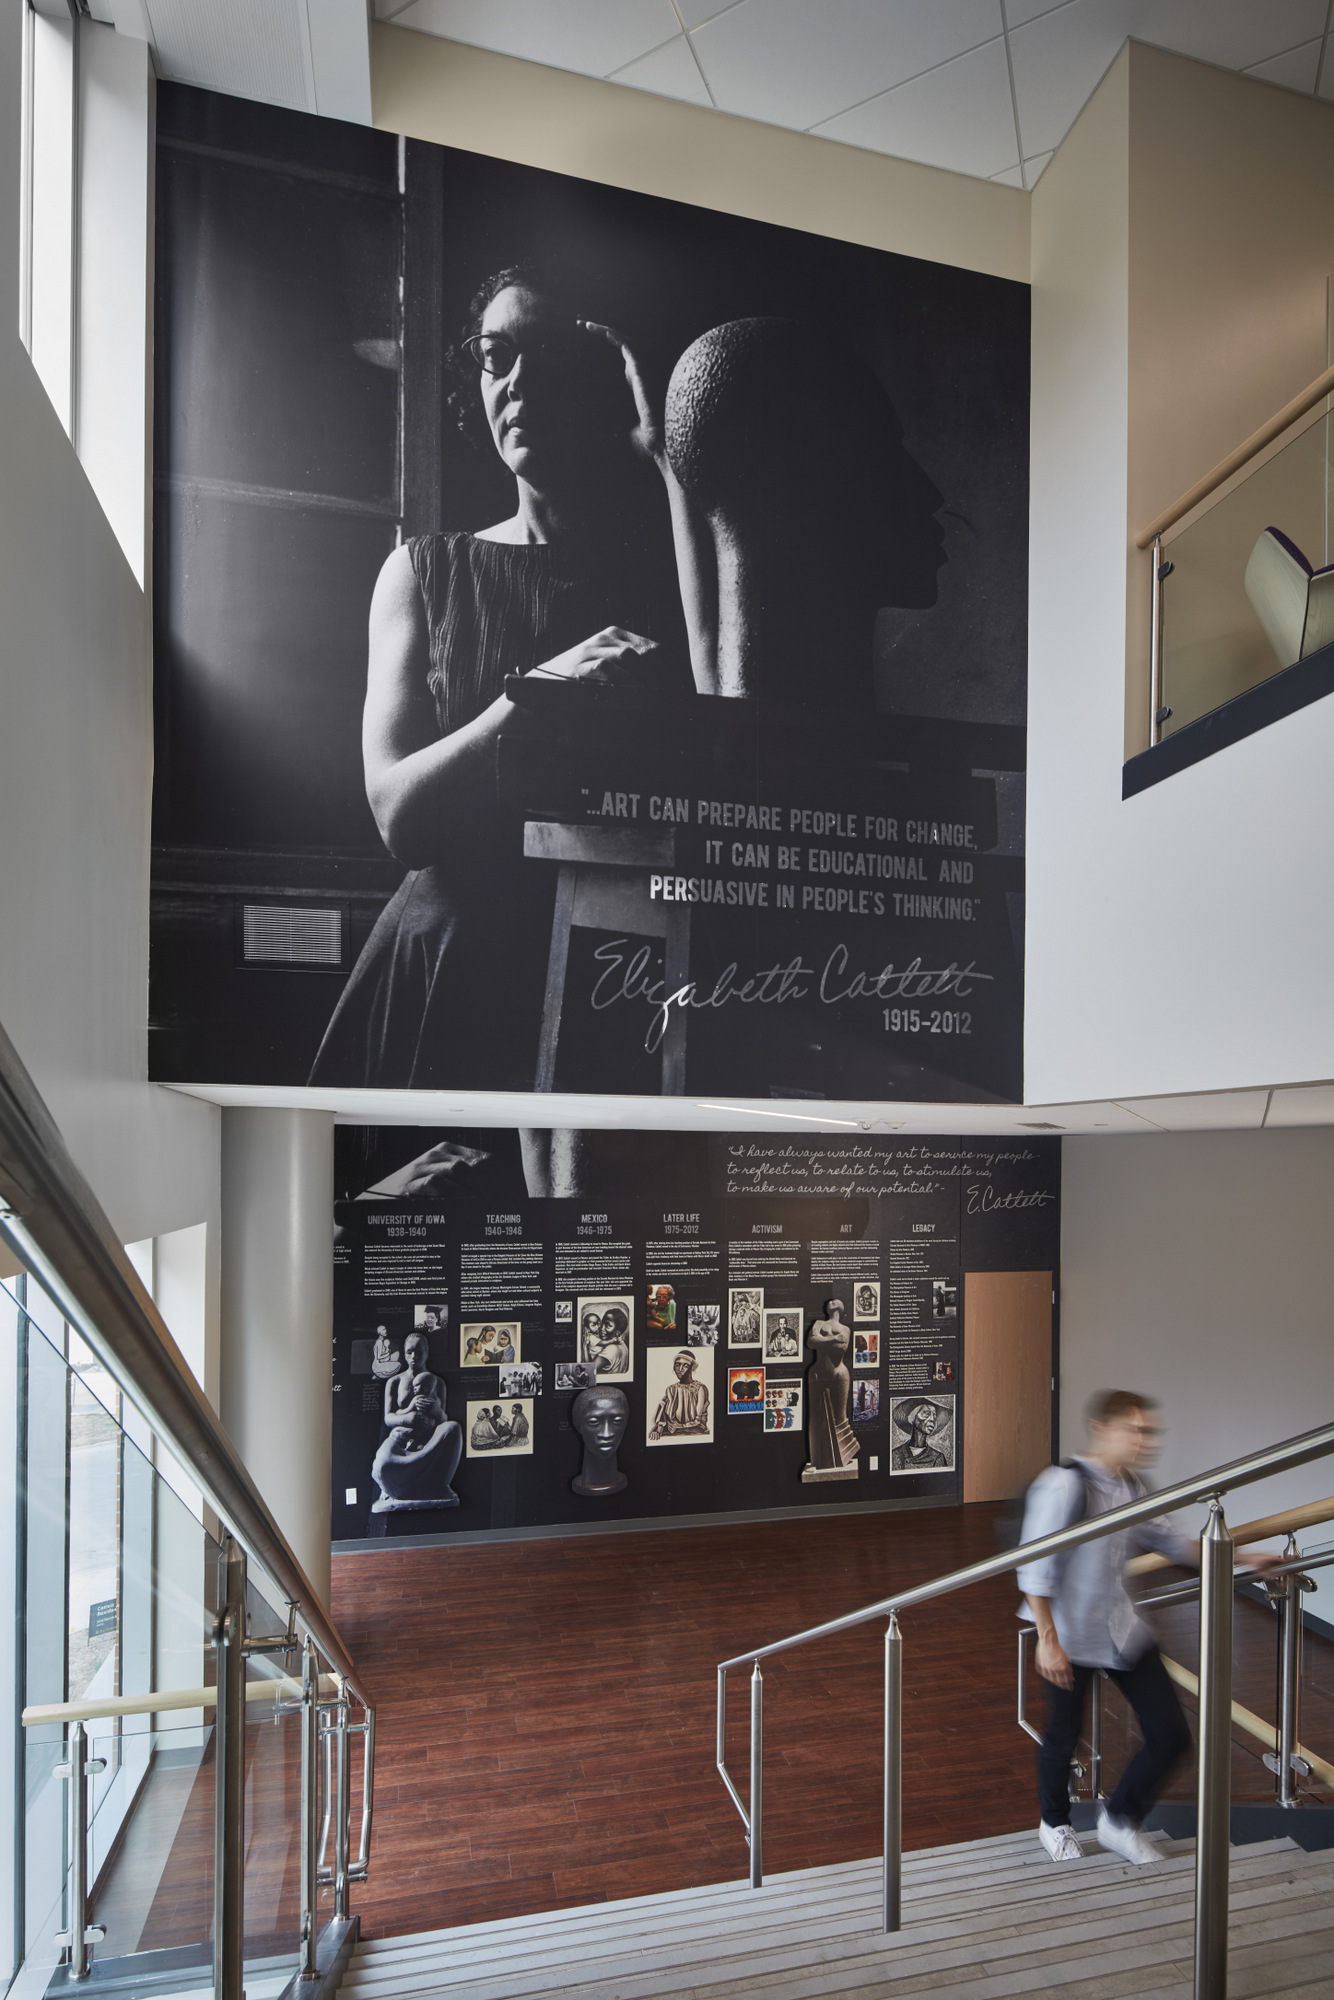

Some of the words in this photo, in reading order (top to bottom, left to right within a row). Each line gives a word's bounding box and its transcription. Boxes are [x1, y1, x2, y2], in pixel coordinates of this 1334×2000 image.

[649, 795, 689, 823] CAN
[698, 799, 782, 831] PREPARE
[790, 807, 857, 838] PEOPLE
[864, 815, 898, 841] FOR
[905, 819, 978, 851] CHANGE,
[705, 840, 723, 865] IT
[731, 841, 769, 869] CAN
[777, 845, 800, 871] BE
[808, 848, 927, 881] EDUCATIONAL
[939, 859, 973, 885] AND
[650, 874, 768, 907] PERSUASIVE
[776, 883, 794, 908] IN
[802, 886, 885, 916] PEOPLE'S
[894, 893, 981, 921] THINKING."
[591, 938, 814, 1054] Elizabeth
[820, 943, 994, 1003] Catlett
[882, 1008, 972, 1035] 1915-2012
[747, 1144, 777, 1157] have
[778, 1145, 826, 1164] always
[827, 1145, 872, 1157] wanted
[874, 1151, 893, 1165] my
[896, 1146, 918, 1158] art
[920, 1146, 932, 1158] to
[932, 1150, 976, 1159] service
[976, 1151, 994, 1166] my
[727, 1162, 741, 1175] to
[741, 1162, 791, 1183] reflect
[791, 1167, 808, 1177] us,
[812, 1163, 826, 1175] to
[827, 1164, 868, 1175] relate
[868, 1164, 882, 1175] to
[882, 1168, 899, 1177] us,
[903, 1164, 915, 1176] to
[915, 1164, 976, 1176] stimulate
[976, 1169, 992, 1178] us,
[727, 1180, 741, 1192] to
[741, 1181, 777, 1193] make
[778, 1185, 795, 1193] us
[797, 1185, 838, 1193] aware
[840, 1181, 856, 1200] of
[855, 1185, 878, 1193] our
[981, 1185, 1056, 1212] Catlett
[367, 1215, 412, 1225] UNIVERSITY
[413, 1215, 424, 1224] OF
[425, 1214, 446, 1224] IOWA
[486, 1214, 521, 1224] TEACHING
[581, 1214, 608, 1223] MEXICO
[663, 1213, 685, 1223] LATER
[686, 1213, 700, 1223] LIFE
[387, 1227, 427, 1237] 1938-1940
[484, 1226, 522, 1236] 1940-1946
[576, 1225, 612, 1235] 1946-1975
[664, 1225, 699, 1234] 1975-2012
[751, 1224, 783, 1234] ACTIVISM
[840, 1224, 852, 1233] ART
[912, 1223, 936, 1233] LEGACY
